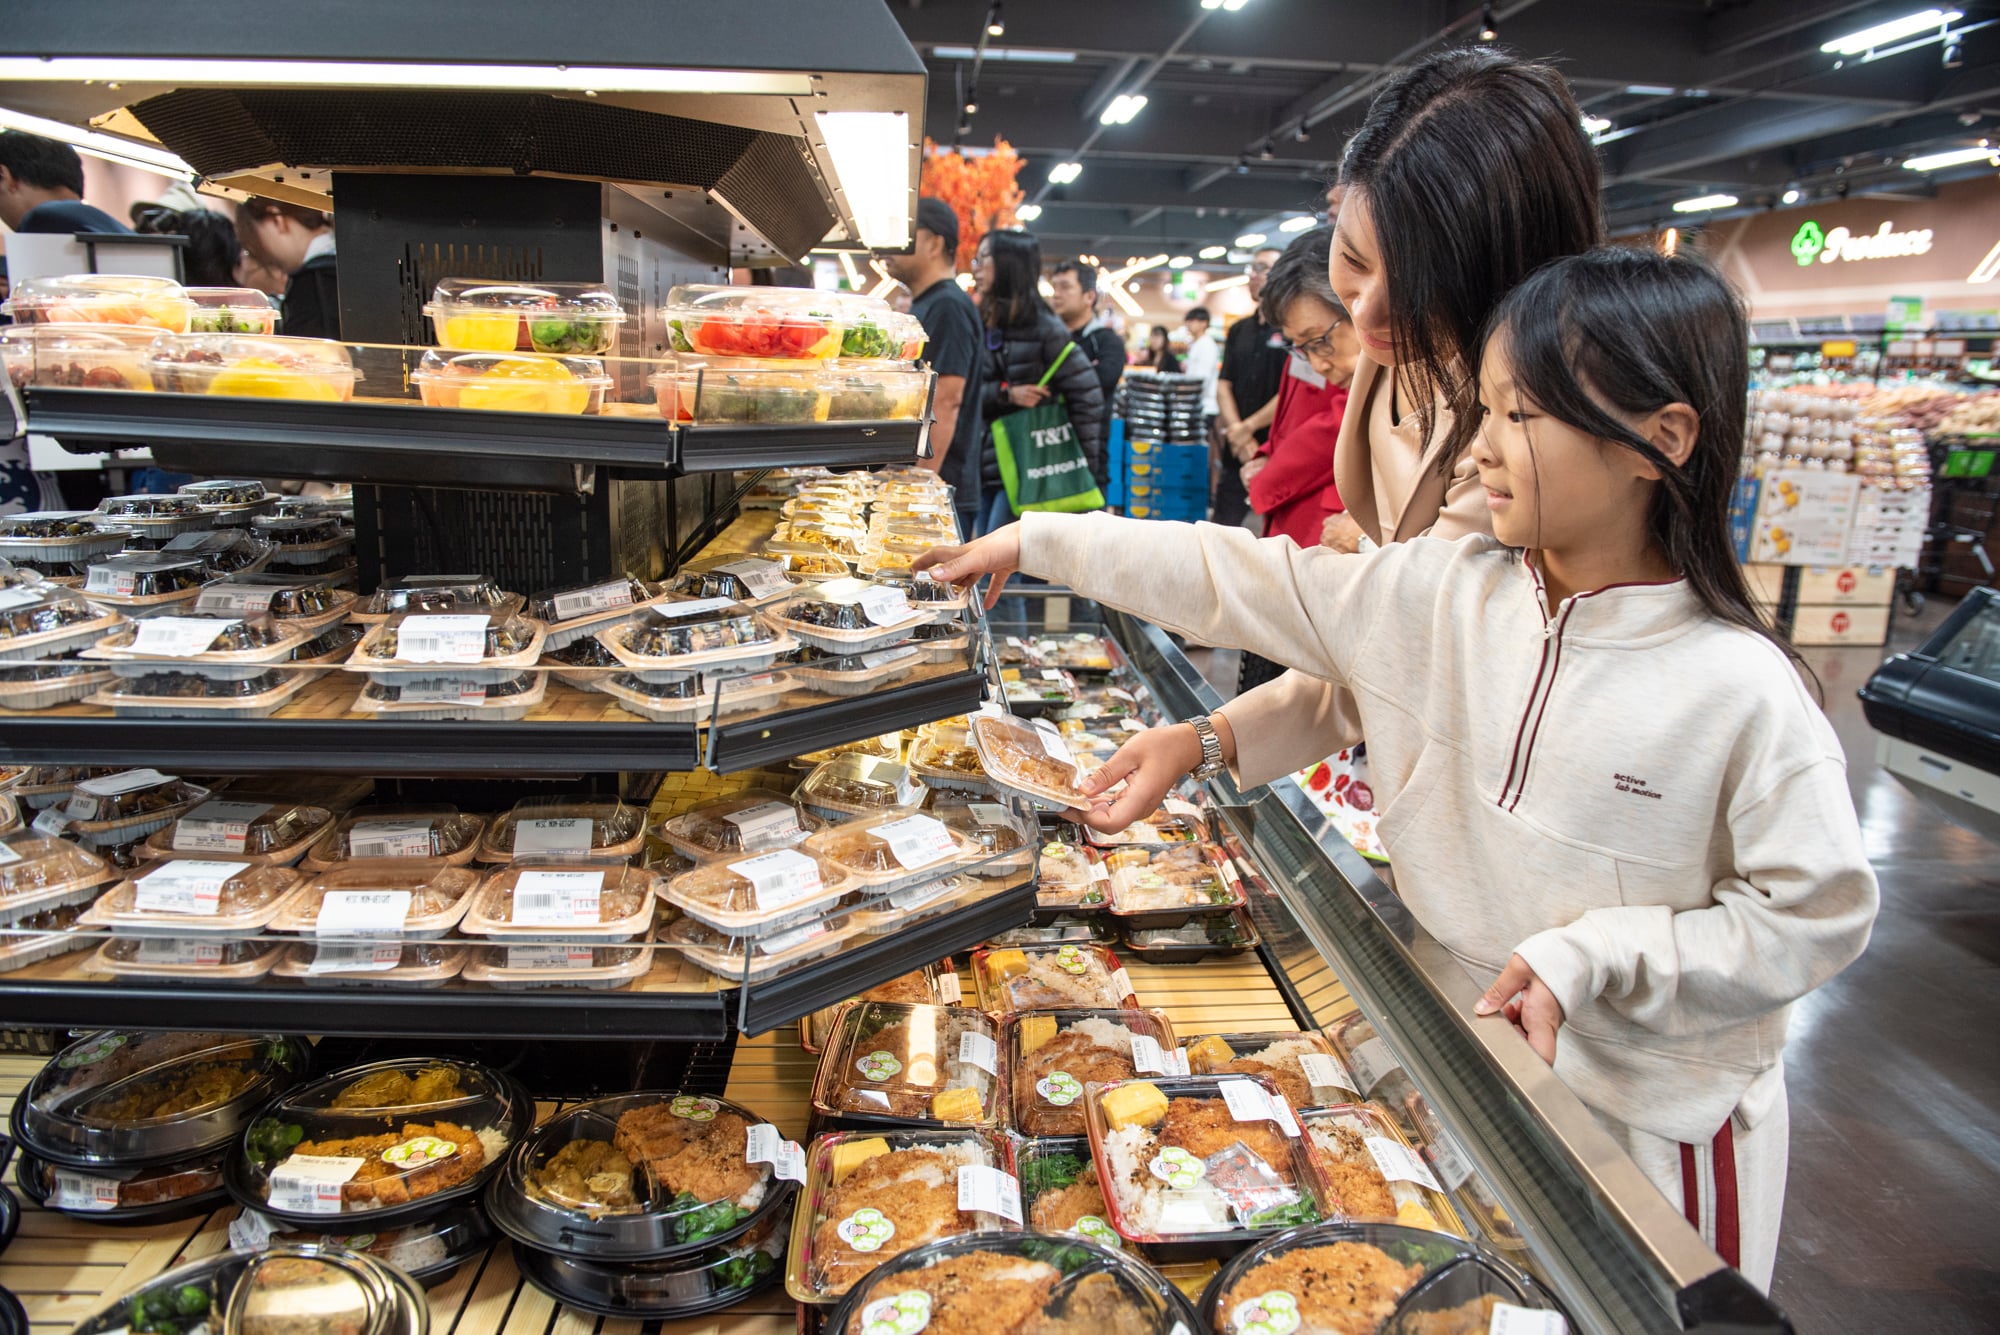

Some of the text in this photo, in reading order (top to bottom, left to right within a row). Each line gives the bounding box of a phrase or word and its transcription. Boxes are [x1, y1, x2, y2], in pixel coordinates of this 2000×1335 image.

[1820, 221, 1933, 264] Produce
[1030, 422, 1073, 448] T&T
[1027, 464, 1054, 479] FOOD
[1054, 460, 1076, 474] FOR
[1613, 772, 1647, 786] active
[1615, 781, 1662, 800] lab motion
